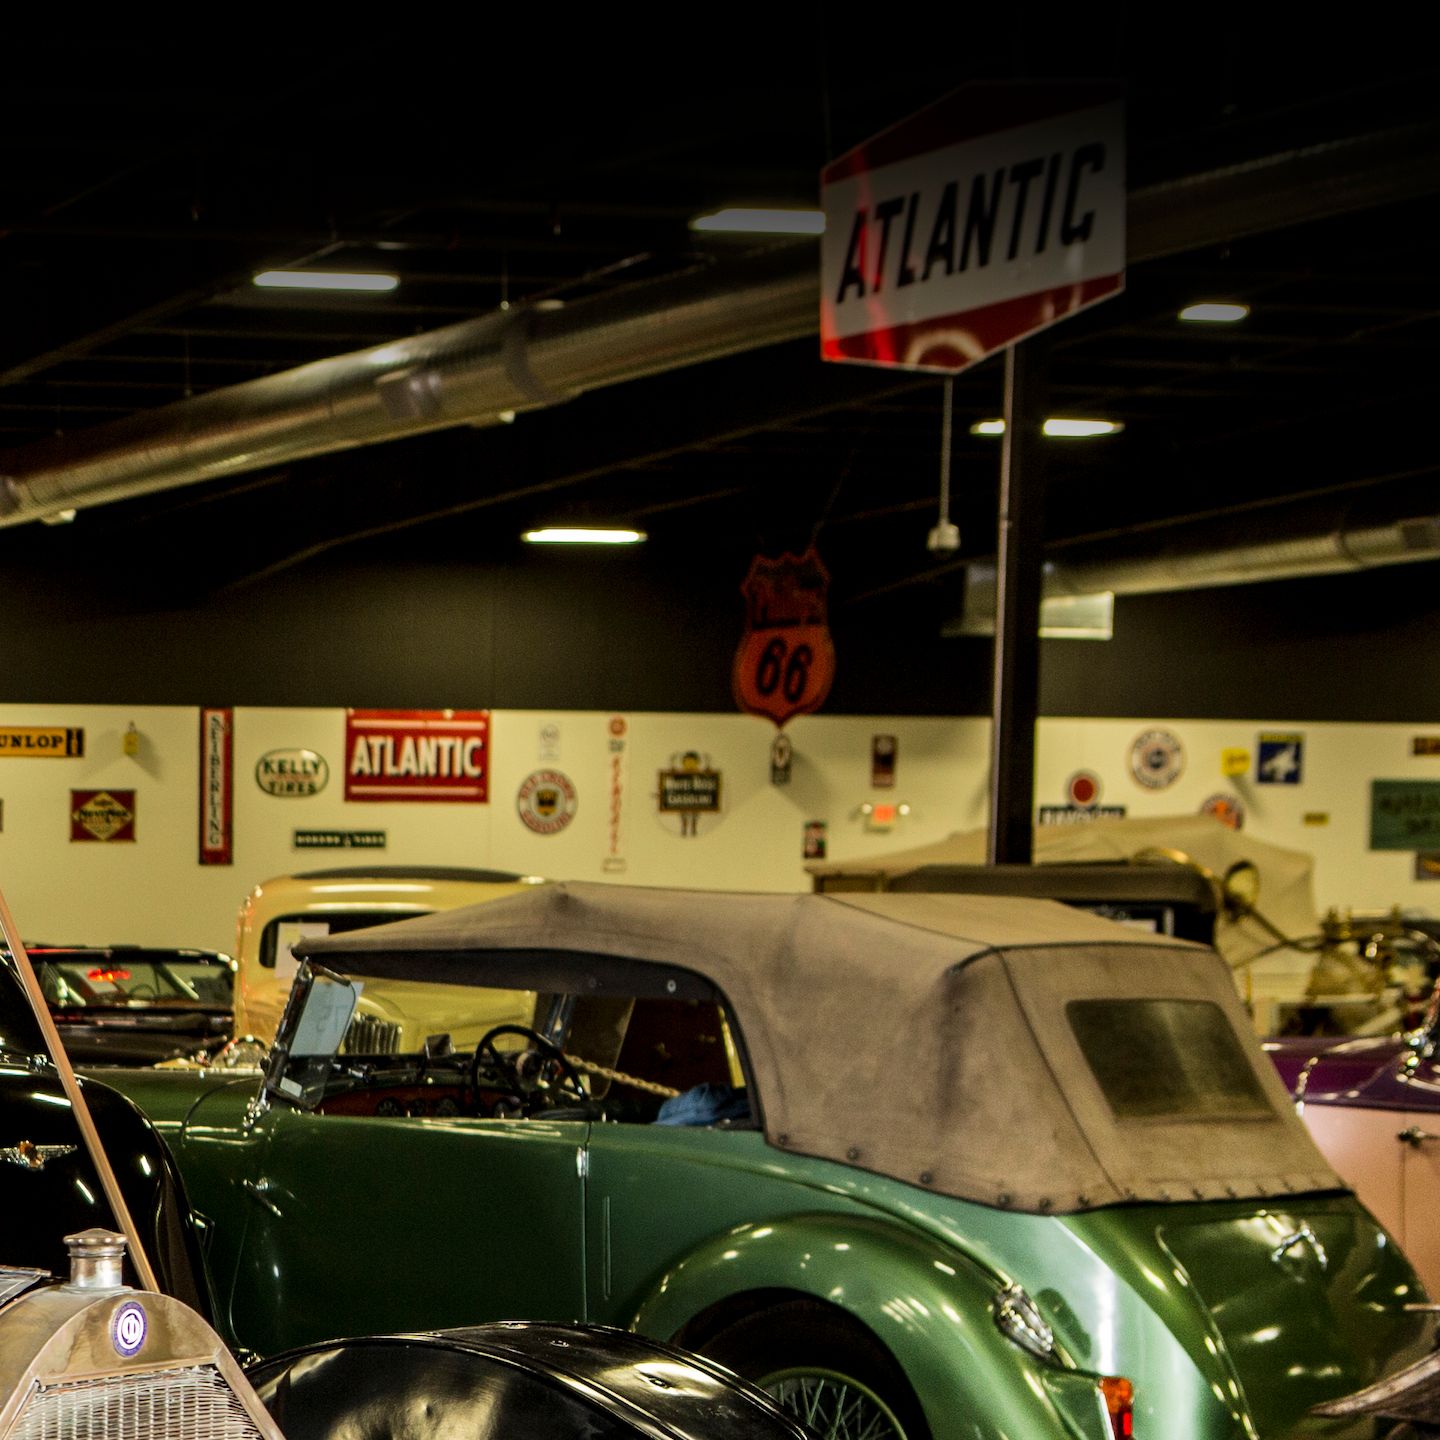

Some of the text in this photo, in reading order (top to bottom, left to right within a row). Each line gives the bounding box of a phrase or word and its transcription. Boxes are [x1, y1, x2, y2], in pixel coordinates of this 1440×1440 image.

[836, 142, 1105, 304] ATLANTIC
[757, 639, 811, 702] 66
[262, 757, 320, 776] KELLY
[350, 735, 483, 777] ATLANTIC
[268, 781, 317, 795] TIRES
